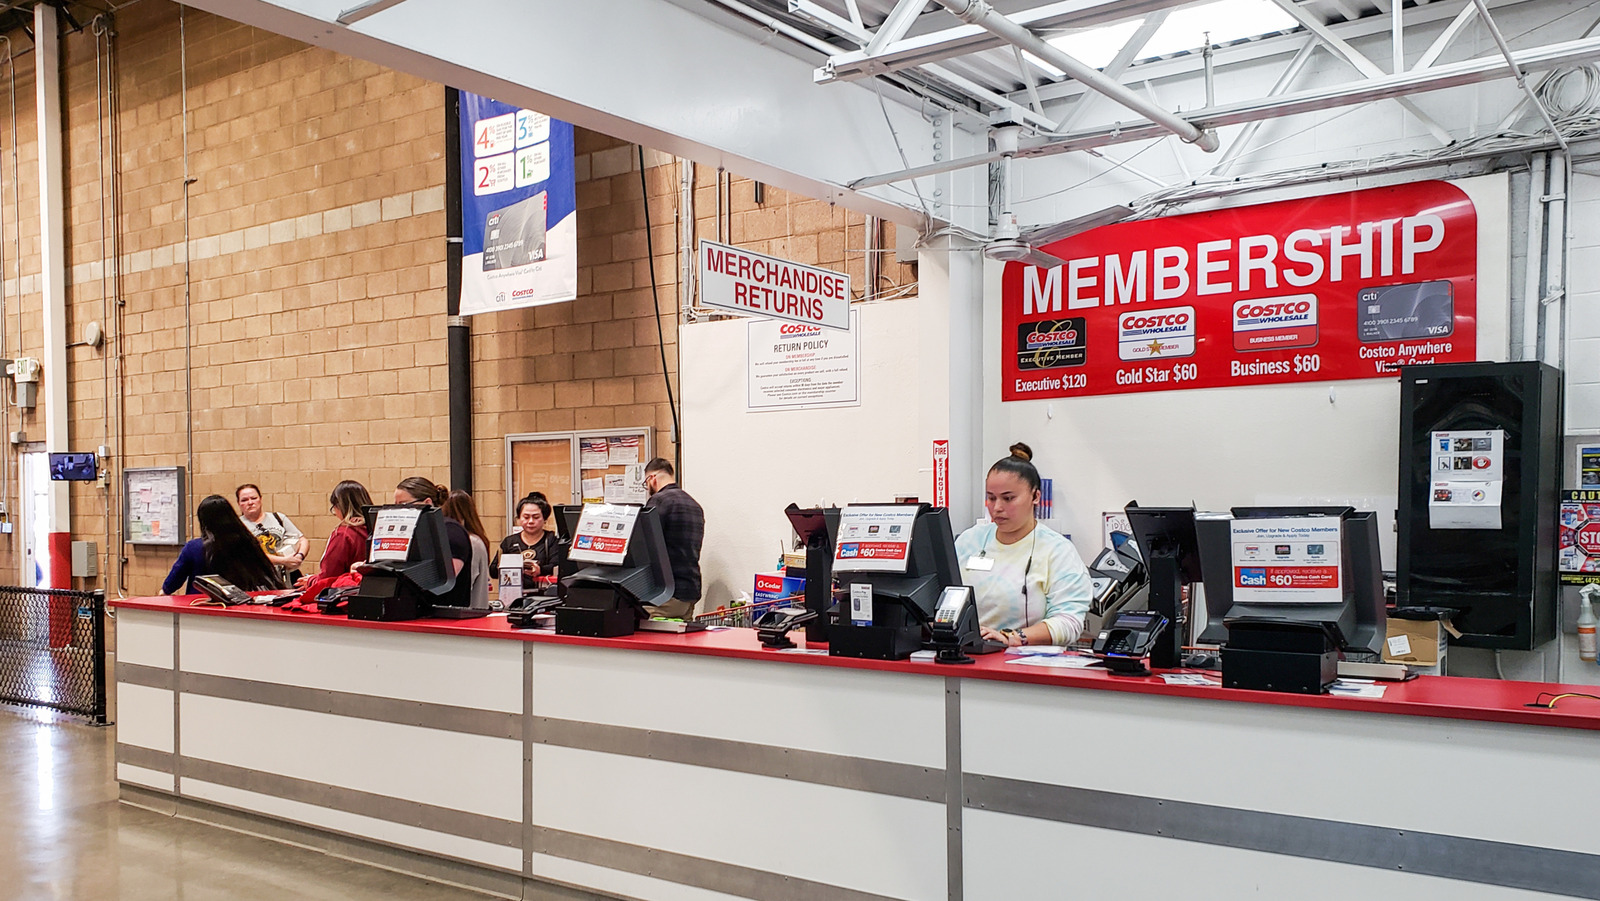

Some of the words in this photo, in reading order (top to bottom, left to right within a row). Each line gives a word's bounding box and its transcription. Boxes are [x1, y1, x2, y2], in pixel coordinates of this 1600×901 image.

[488, 214, 500, 226] citi
[528, 248, 544, 260] VISA
[1023, 214, 1445, 316] MEMBERSHIP
[707, 247, 845, 300] MERCHANDISE
[495, 292, 506, 303] citi
[511, 288, 534, 297] COSTCO
[735, 281, 824, 321] RETURNS
[1362, 290, 1378, 301] citi
[1236, 301, 1311, 319] COSTCO
[1122, 313, 1189, 330] COSTCO
[1259, 313, 1309, 324] WHOLESALE
[1142, 325, 1187, 334] WHOLESALE
[1428, 325, 1449, 334] VISA
[1026, 330, 1077, 344] COSTCO
[1042, 339, 1075, 347] WHOLESALE
[1249, 336, 1275, 344] BUSINESS
[773, 342, 802, 353] RETURN
[803, 339, 829, 350] POLICY
[1359, 345, 1395, 359] Costco
[1398, 341, 1452, 358] Anywhere
[1020, 355, 1054, 364] EXECUTIVE
[1056, 352, 1083, 360] MEMBER
[17, 359, 28, 375] EXIT
[1231, 358, 1290, 377] Business
[1293, 353, 1321, 375] $60
[1115, 368, 1143, 385] Gold
[1145, 366, 1171, 383] Star
[1173, 362, 1198, 383] $60
[1015, 376, 1061, 393] Executive
[1062, 373, 1087, 391] $120
[935, 447, 946, 455] FIRE
[593, 541, 605, 550] $60
[840, 548, 858, 557] Cash
[860, 548, 875, 557] $60
[1240, 575, 1266, 586] Cash
[1270, 575, 1292, 586] $60
